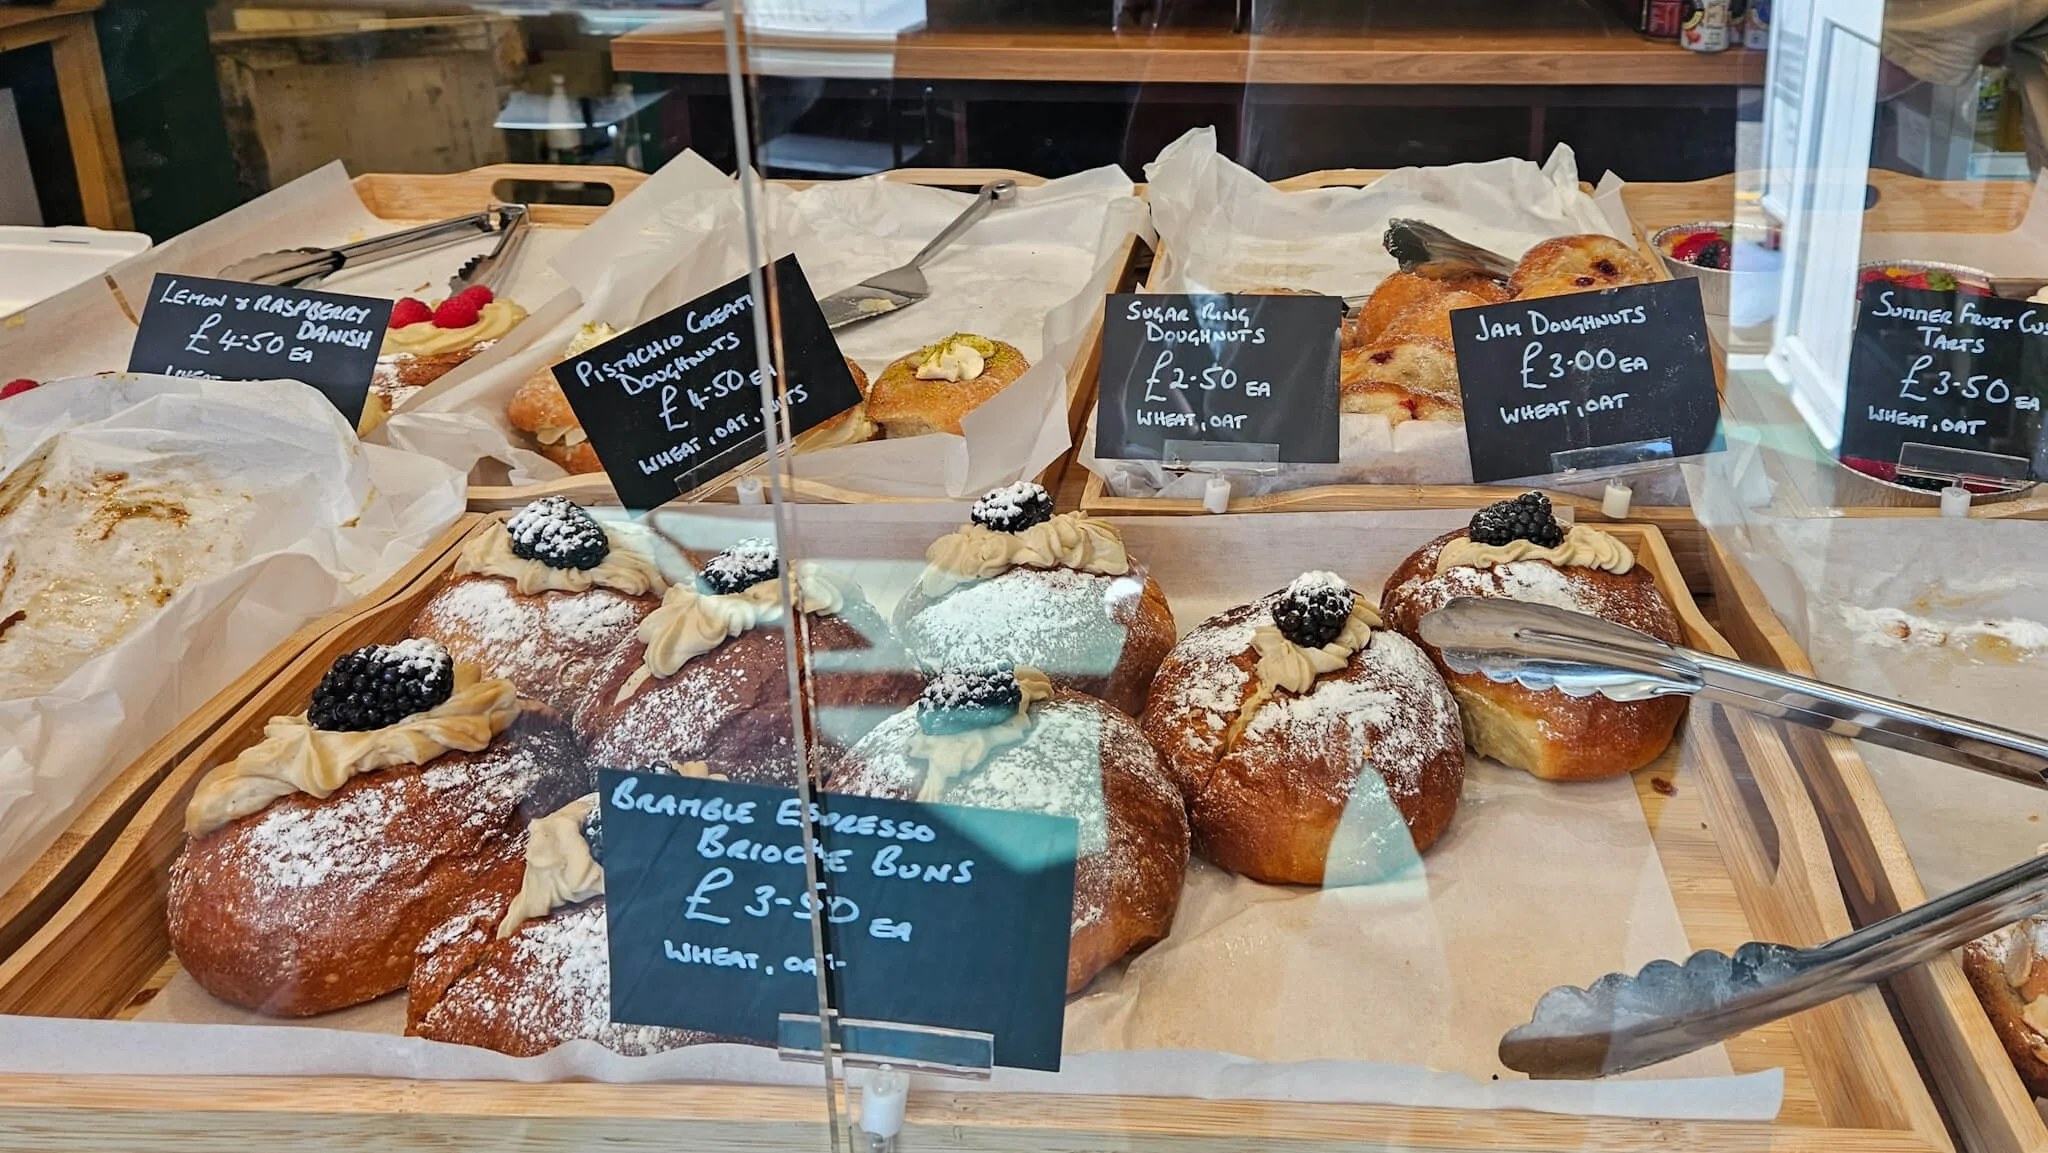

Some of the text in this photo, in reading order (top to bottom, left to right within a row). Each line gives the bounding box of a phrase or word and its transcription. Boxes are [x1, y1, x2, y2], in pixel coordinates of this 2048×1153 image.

[160, 280, 226, 307] LEMON
[253, 295, 372, 324] RASPBERRY
[1126, 300, 1250, 328] SUGAR RING
[1872, 291, 1953, 324] SUMMER
[1959, 303, 2014, 329] FRUIT
[295, 320, 374, 350] DANISH
[1145, 321, 1266, 346] DOUGHNUTS
[1475, 306, 1648, 341] JAM DOUGHNUTS
[287, 346, 313, 363] EA
[575, 293, 754, 387] PISTACHIO CREAM
[1917, 326, 1985, 354] TARTS
[616, 331, 741, 396] DOUGHNUTS
[1619, 357, 1648, 373] EA
[1245, 381, 1271, 397] EA
[2014, 396, 2040, 411] EA
[611, 777, 757, 824] BRAMBLE
[697, 824, 975, 885] BRIOCHE BUNS
[869, 917, 912, 942] EA
